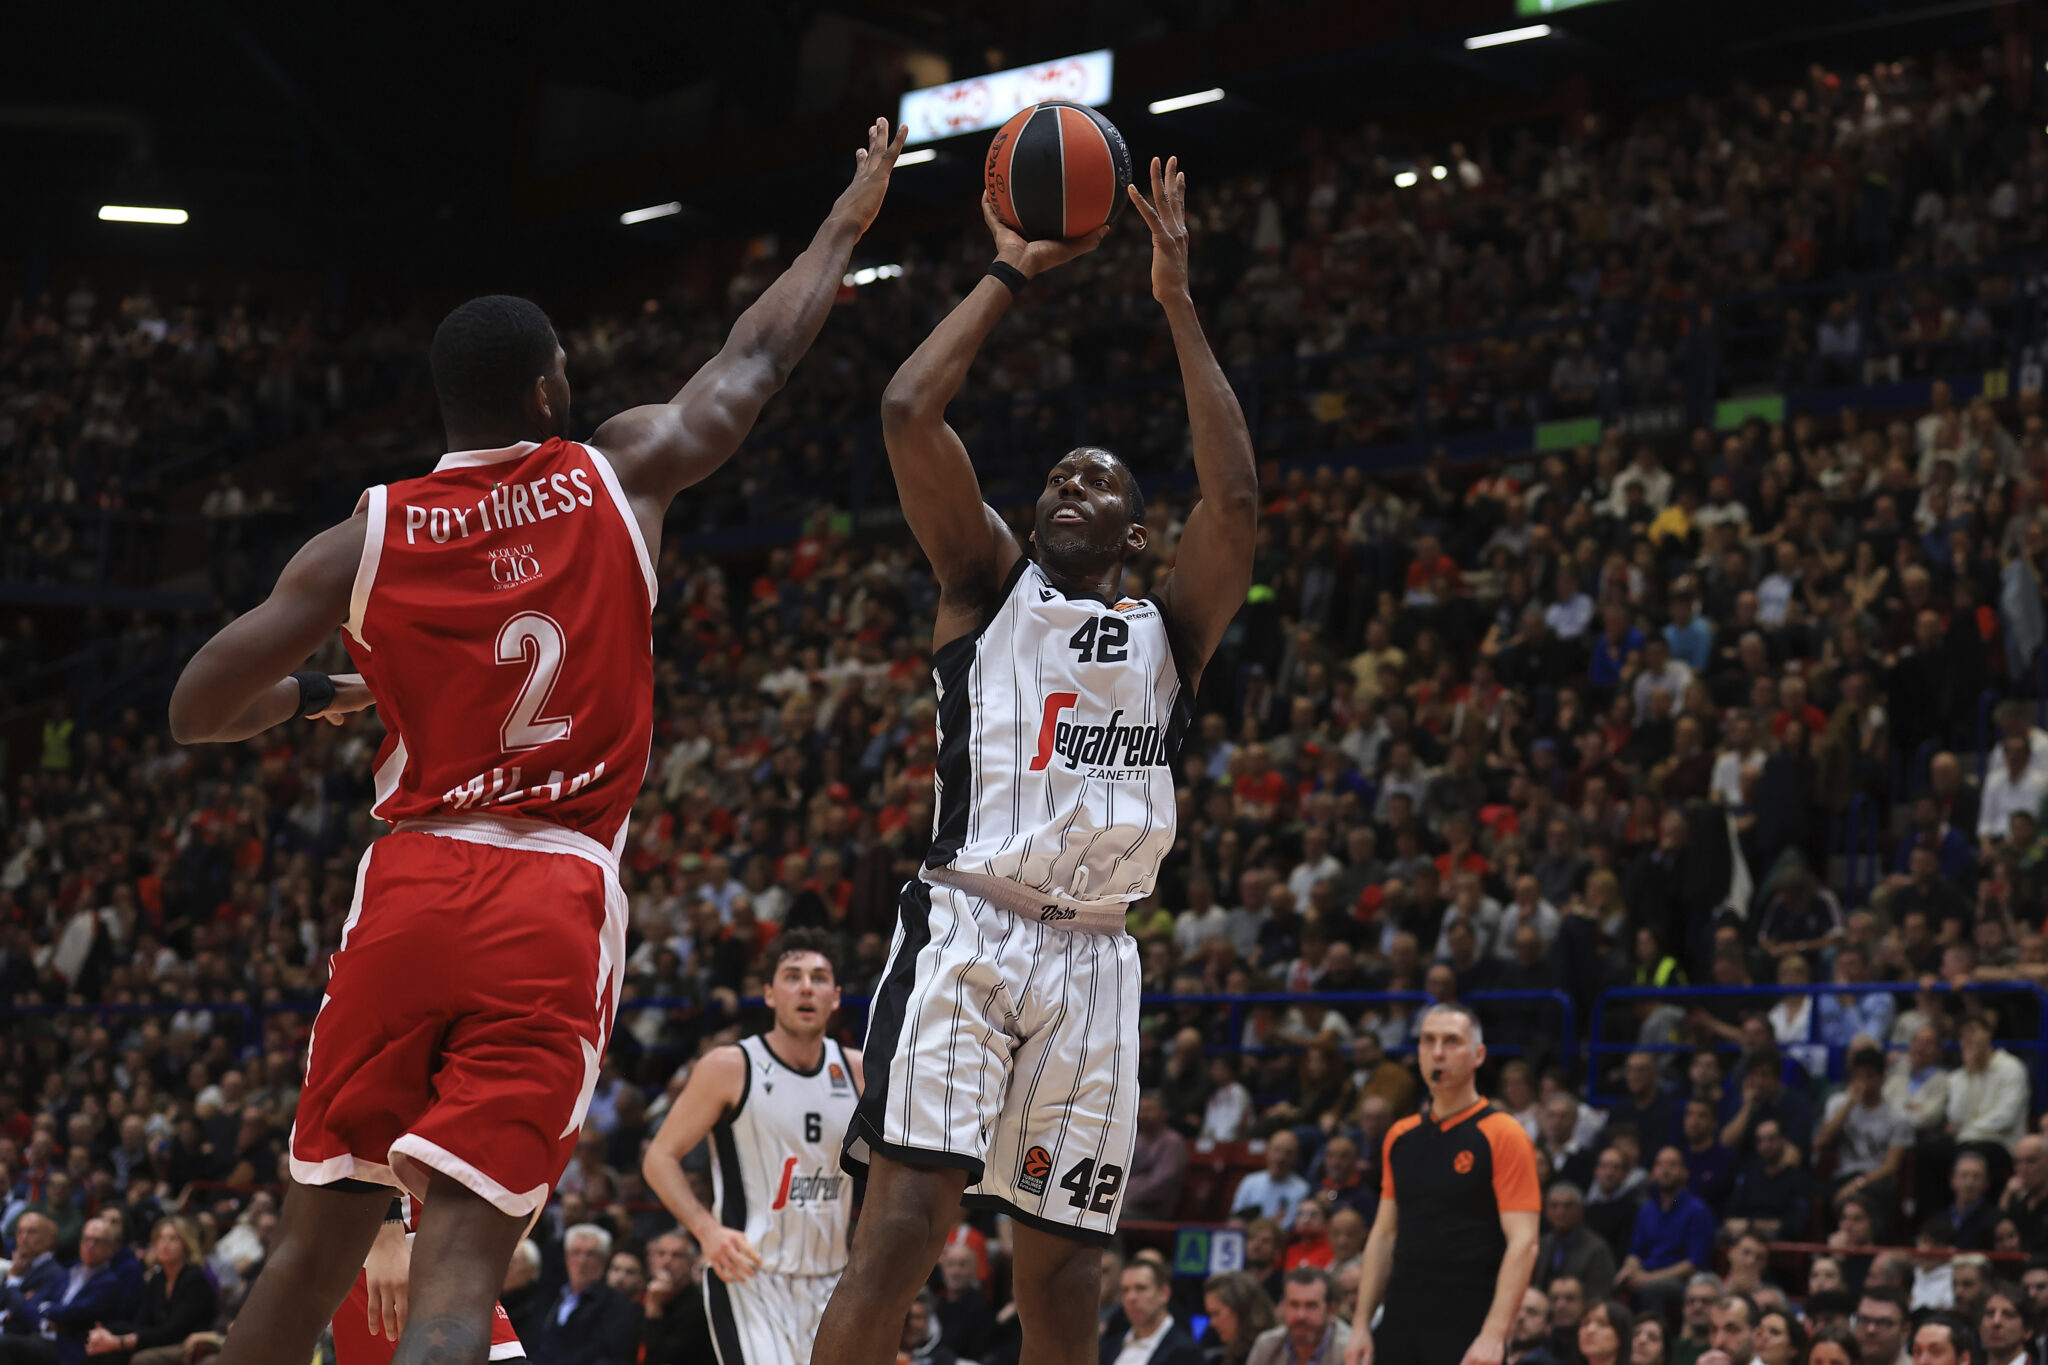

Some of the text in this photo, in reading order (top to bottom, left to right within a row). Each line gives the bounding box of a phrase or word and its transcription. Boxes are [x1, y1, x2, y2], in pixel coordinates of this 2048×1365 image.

[488, 543, 534, 560] ACQUA DI
[1069, 616, 1129, 663] 42
[494, 610, 573, 754] 2
[1088, 768, 1146, 781] ZANETTI
[805, 1112, 822, 1143] 6
[1059, 1157, 1123, 1214] 42
